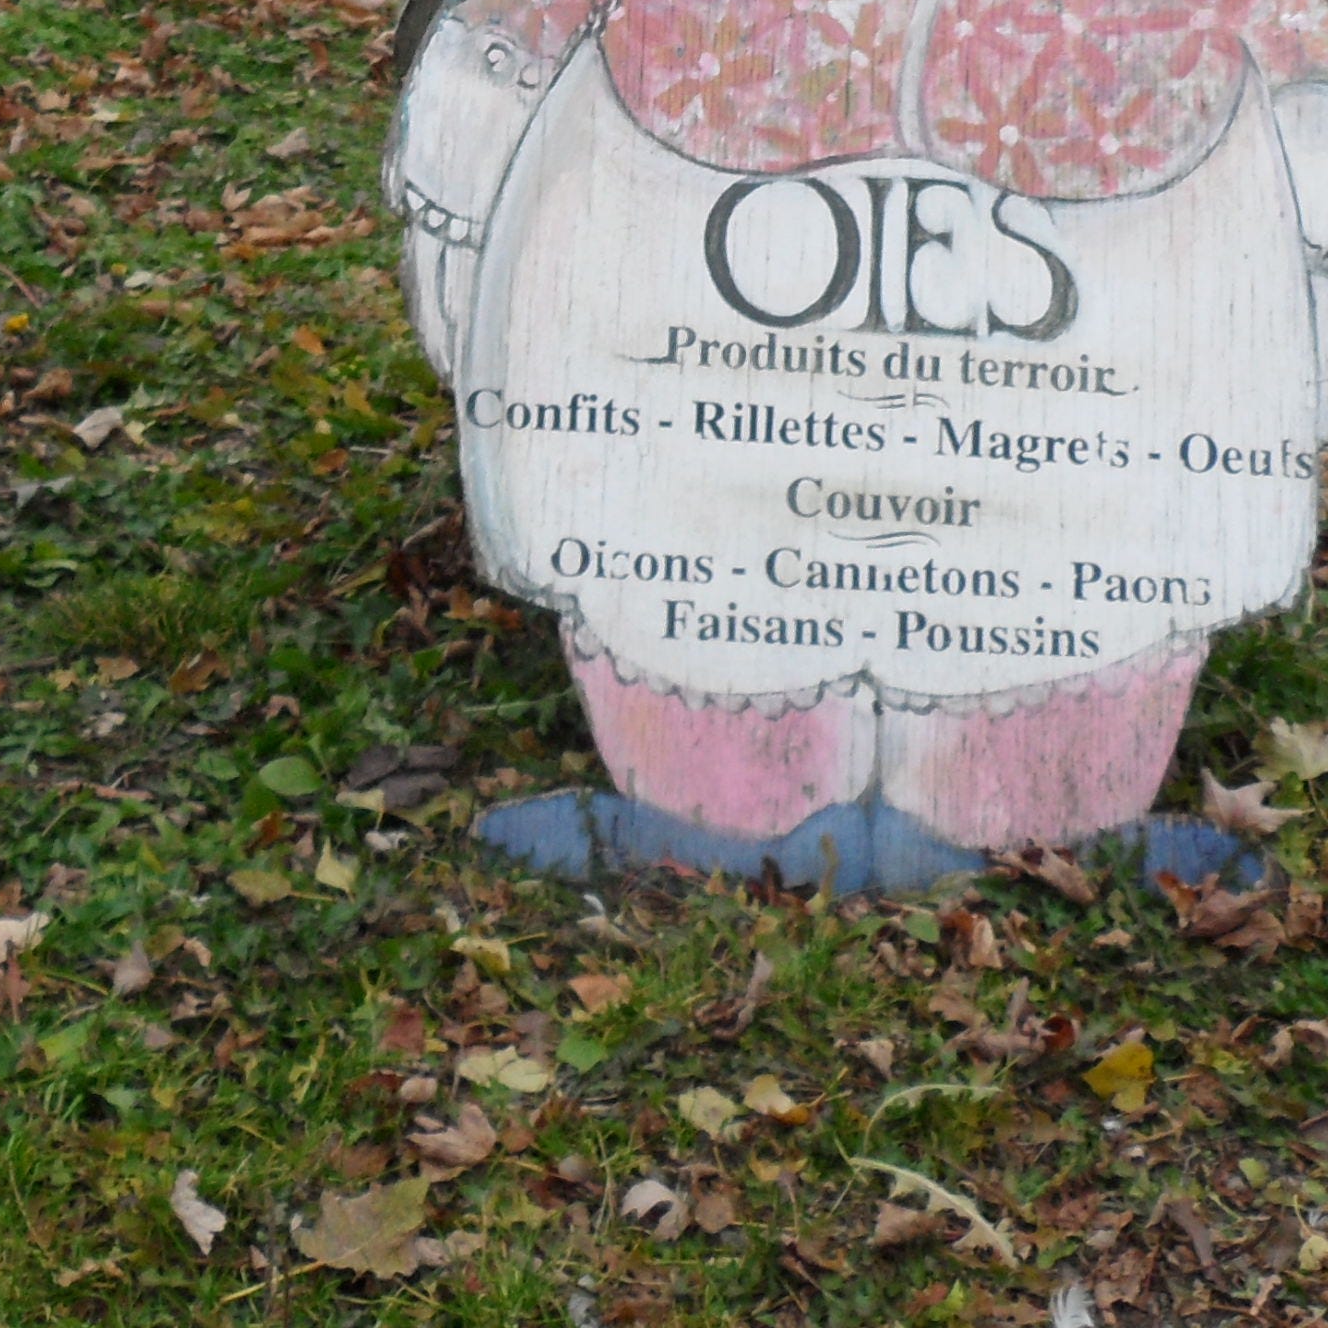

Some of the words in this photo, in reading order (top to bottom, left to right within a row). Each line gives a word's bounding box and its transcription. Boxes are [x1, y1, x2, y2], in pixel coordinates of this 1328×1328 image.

[703, 174, 1080, 342] OIES
[652, 324, 868, 380] Produits
[882, 341, 941, 383] du
[959, 349, 1127, 396] terroir
[465, 387, 641, 437] Confits
[692, 400, 887, 453] Rillettes
[934, 416, 1131, 474] Magrets
[785, 476, 982, 528] Couvoir
[1070, 560, 1212, 606] Paons
[660, 598, 846, 648] Faisans
[894, 609, 1101, 659] Poussins
